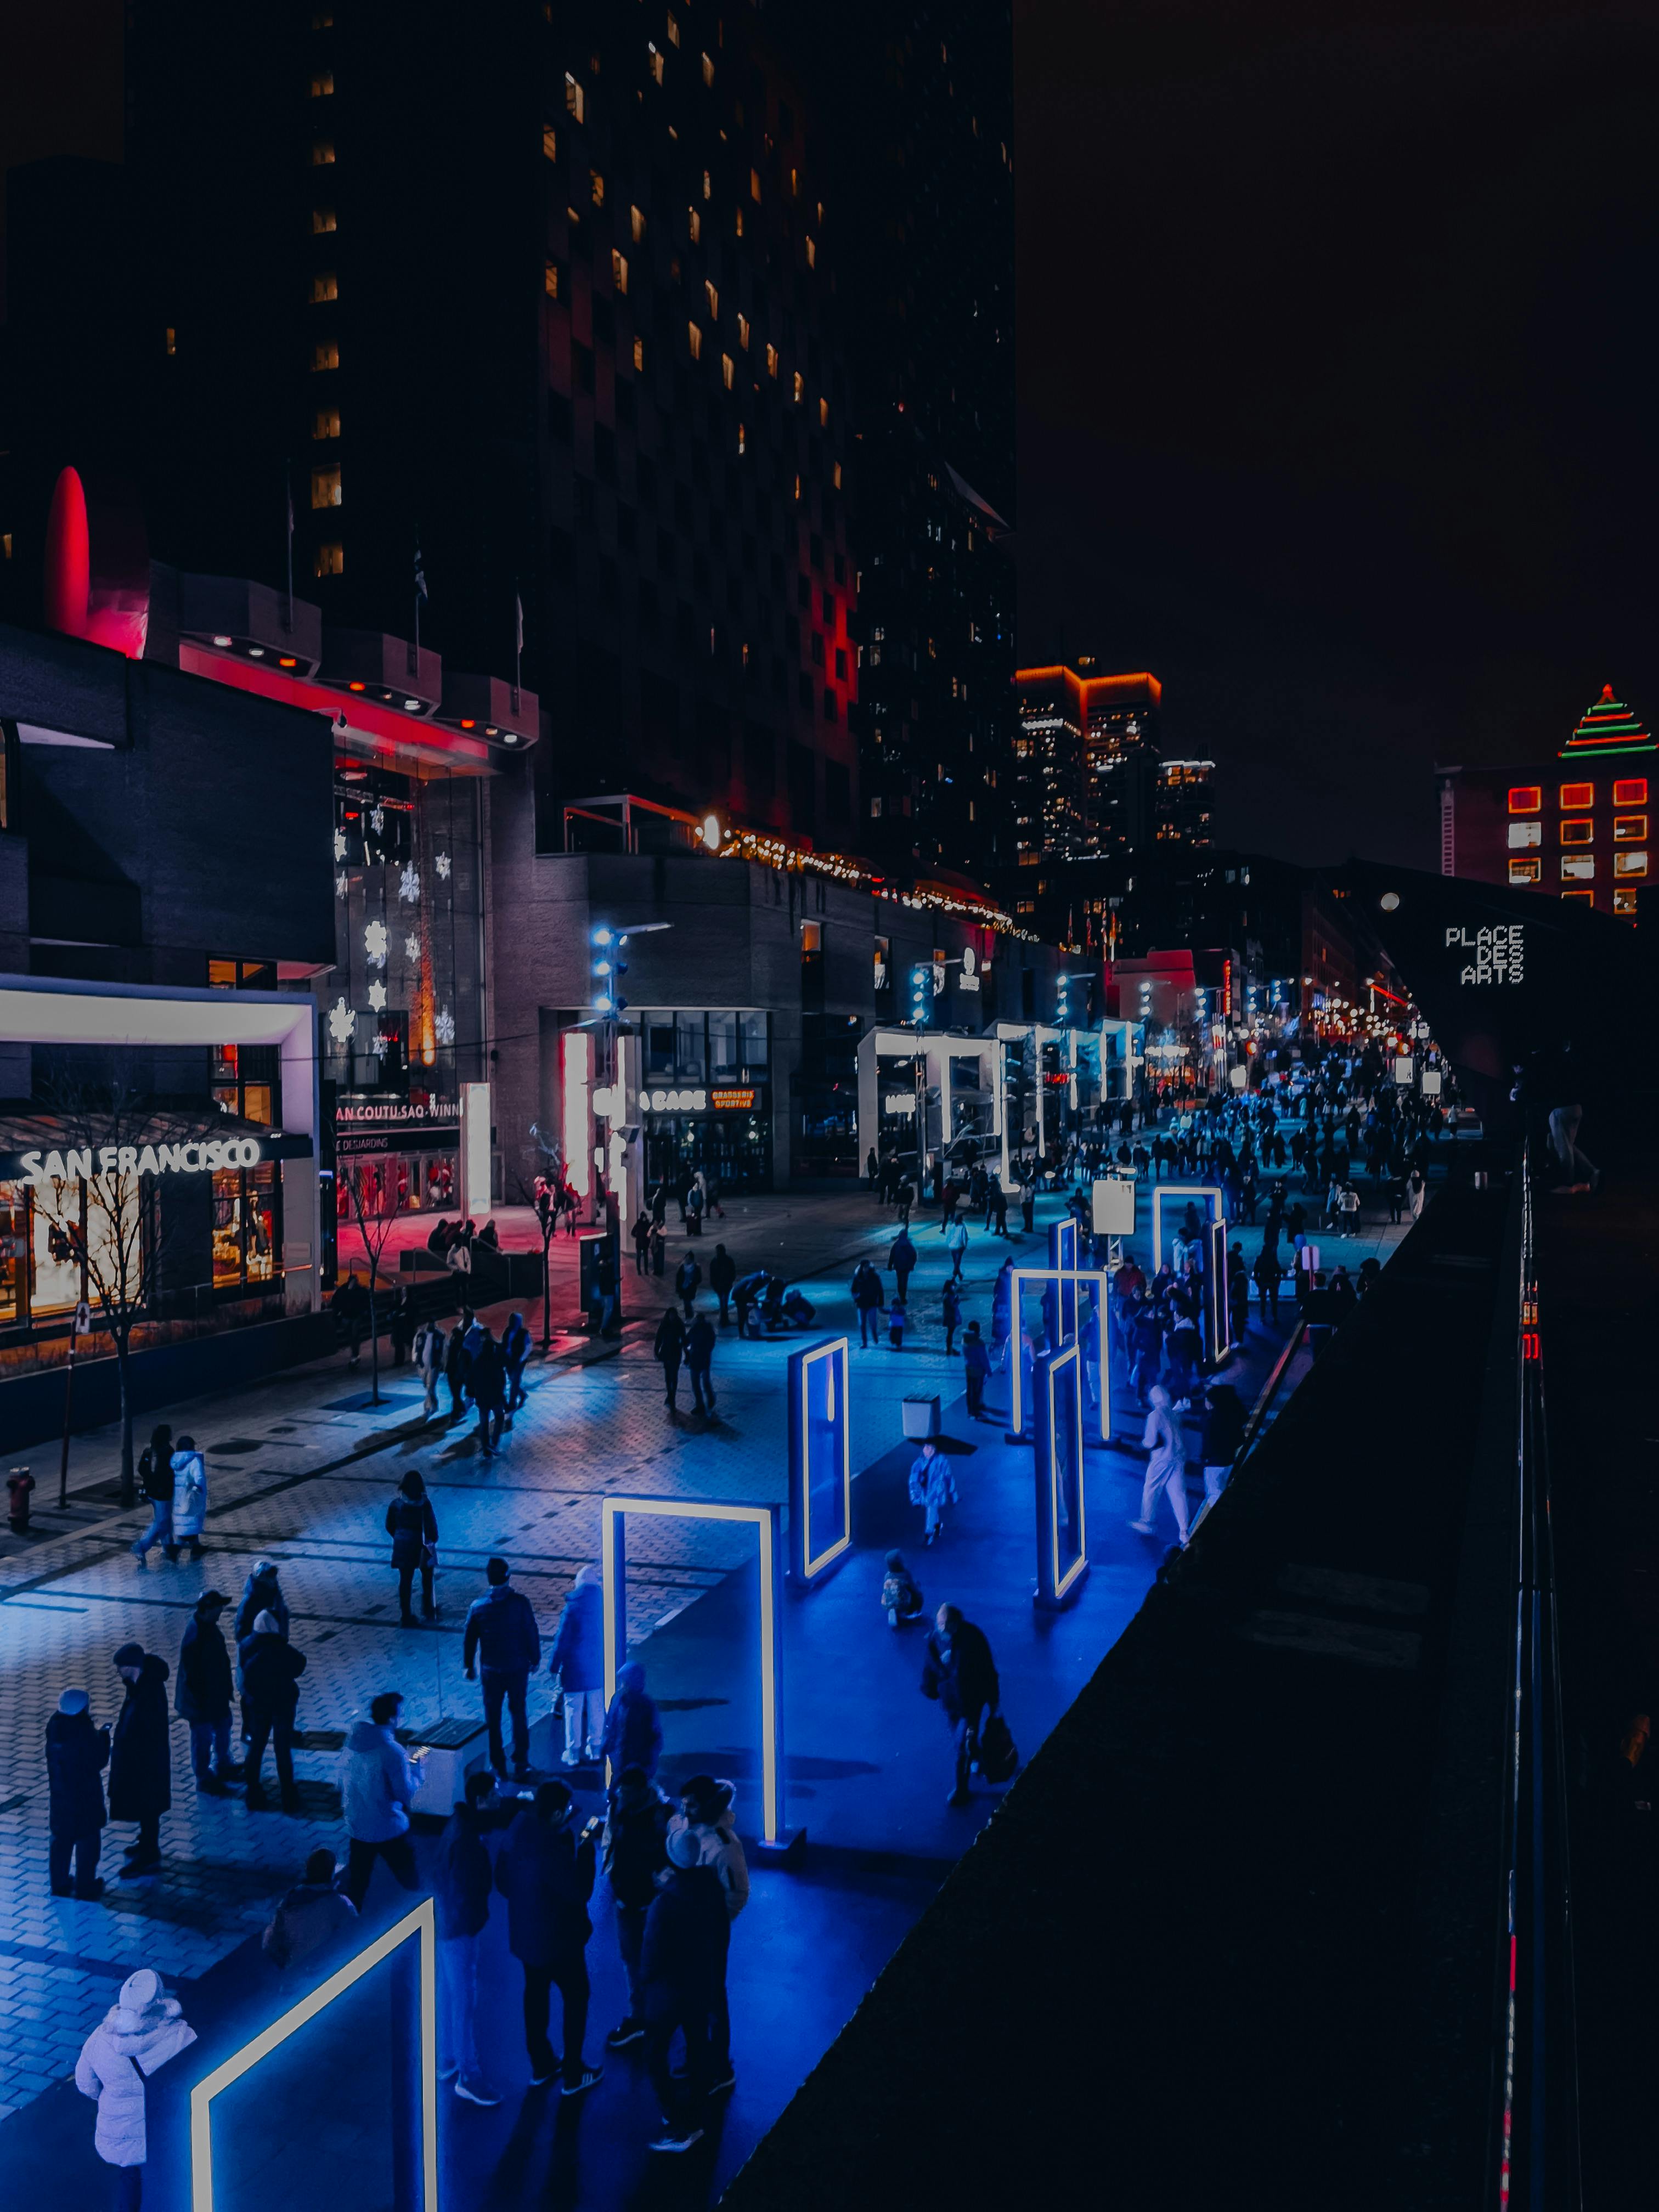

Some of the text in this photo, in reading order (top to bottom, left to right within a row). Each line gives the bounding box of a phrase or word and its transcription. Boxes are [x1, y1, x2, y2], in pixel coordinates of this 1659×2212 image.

[1446, 926, 1523, 946] PLACE
[1477, 945, 1523, 965] DES
[1462, 964, 1523, 984] ARTS
[336, 1103, 460, 1120] AN COUTU SAQ WINN
[343, 1137, 388, 1150] DESJARDINS
[20, 1138, 260, 1184] SAN FRANCISCO
